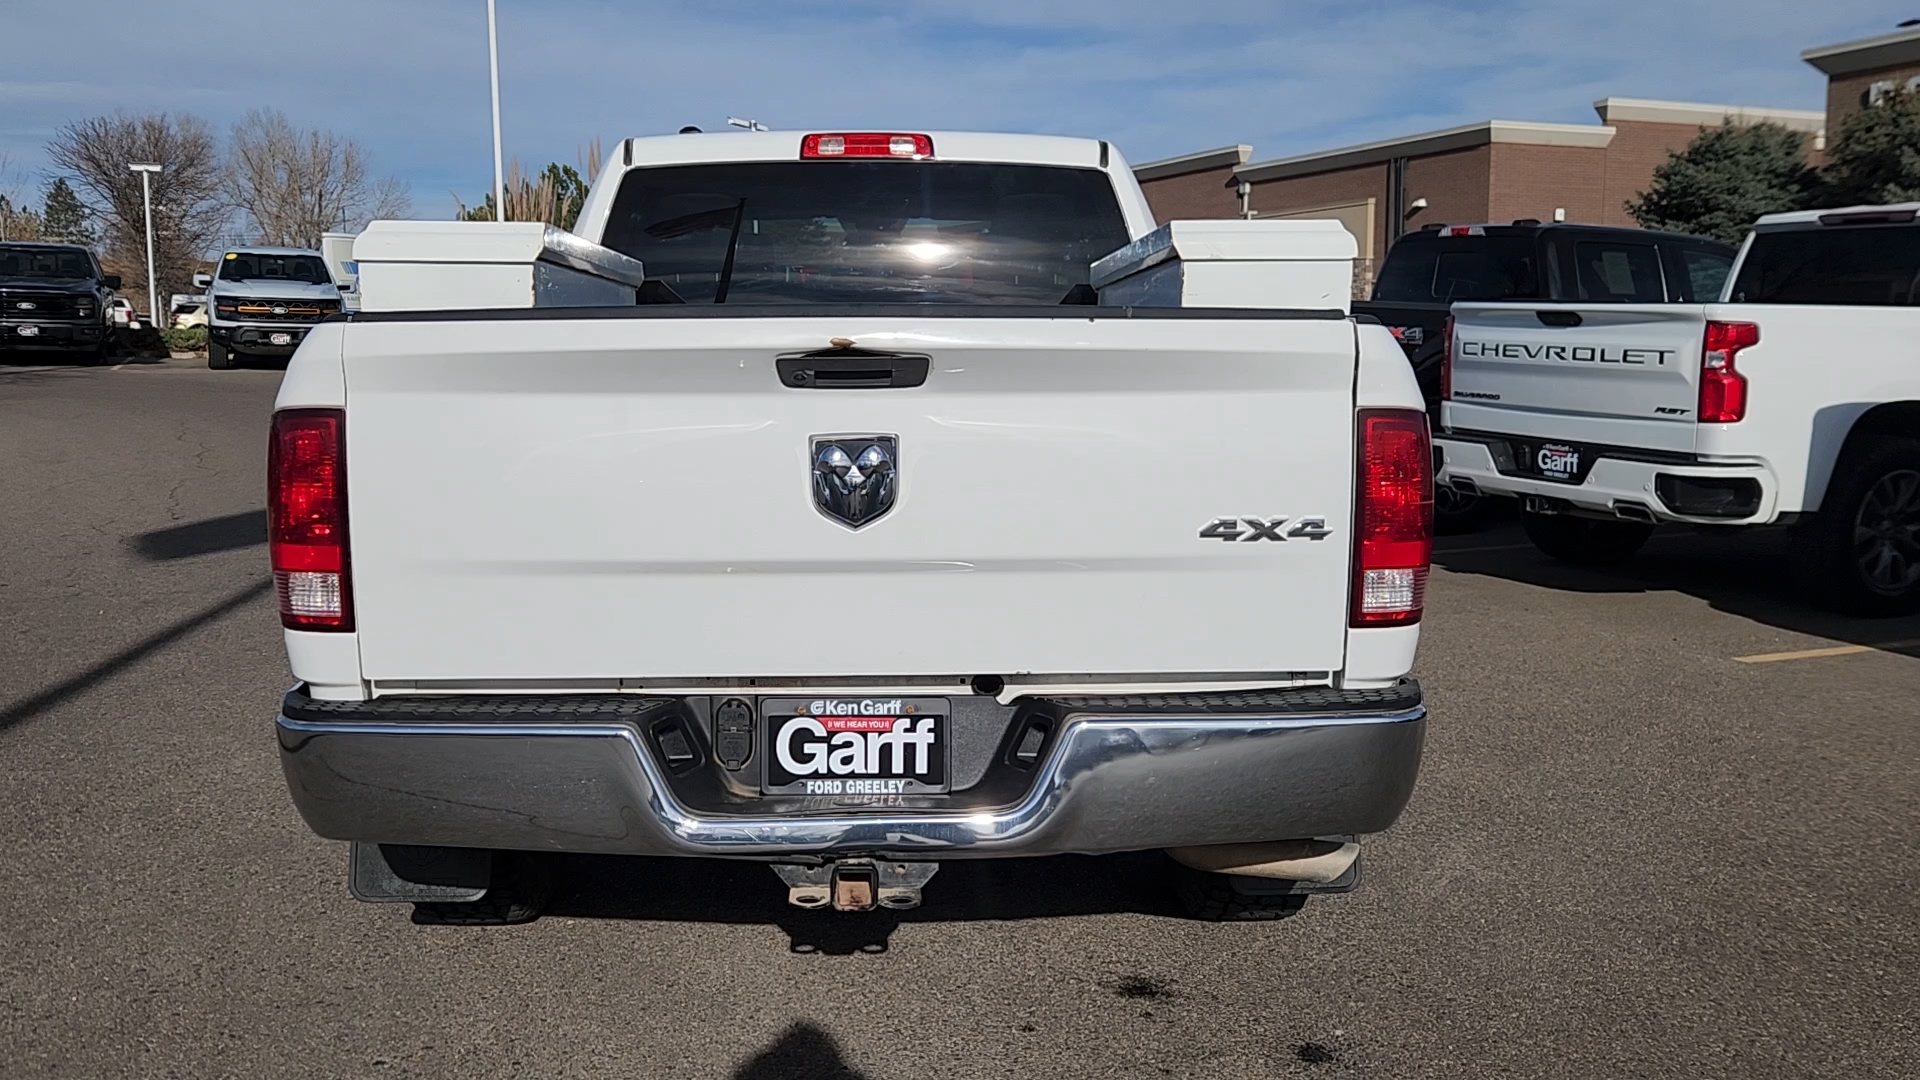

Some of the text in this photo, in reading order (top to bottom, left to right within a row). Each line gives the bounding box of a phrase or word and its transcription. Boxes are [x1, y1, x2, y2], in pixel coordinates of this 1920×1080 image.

[1387, 326, 1423, 340] X4
[1462, 341, 1676, 365] CHEVROLET
[1654, 406, 1691, 415] RST
[1538, 449, 1579, 473] Garff
[1199, 516, 1334, 542] 4X4
[825, 700, 902, 715] Ken Garff
[833, 721, 885, 729] WE HEAR YOU
[776, 717, 935, 775] Garff
[807, 780, 905, 794] FORD GREELEY
